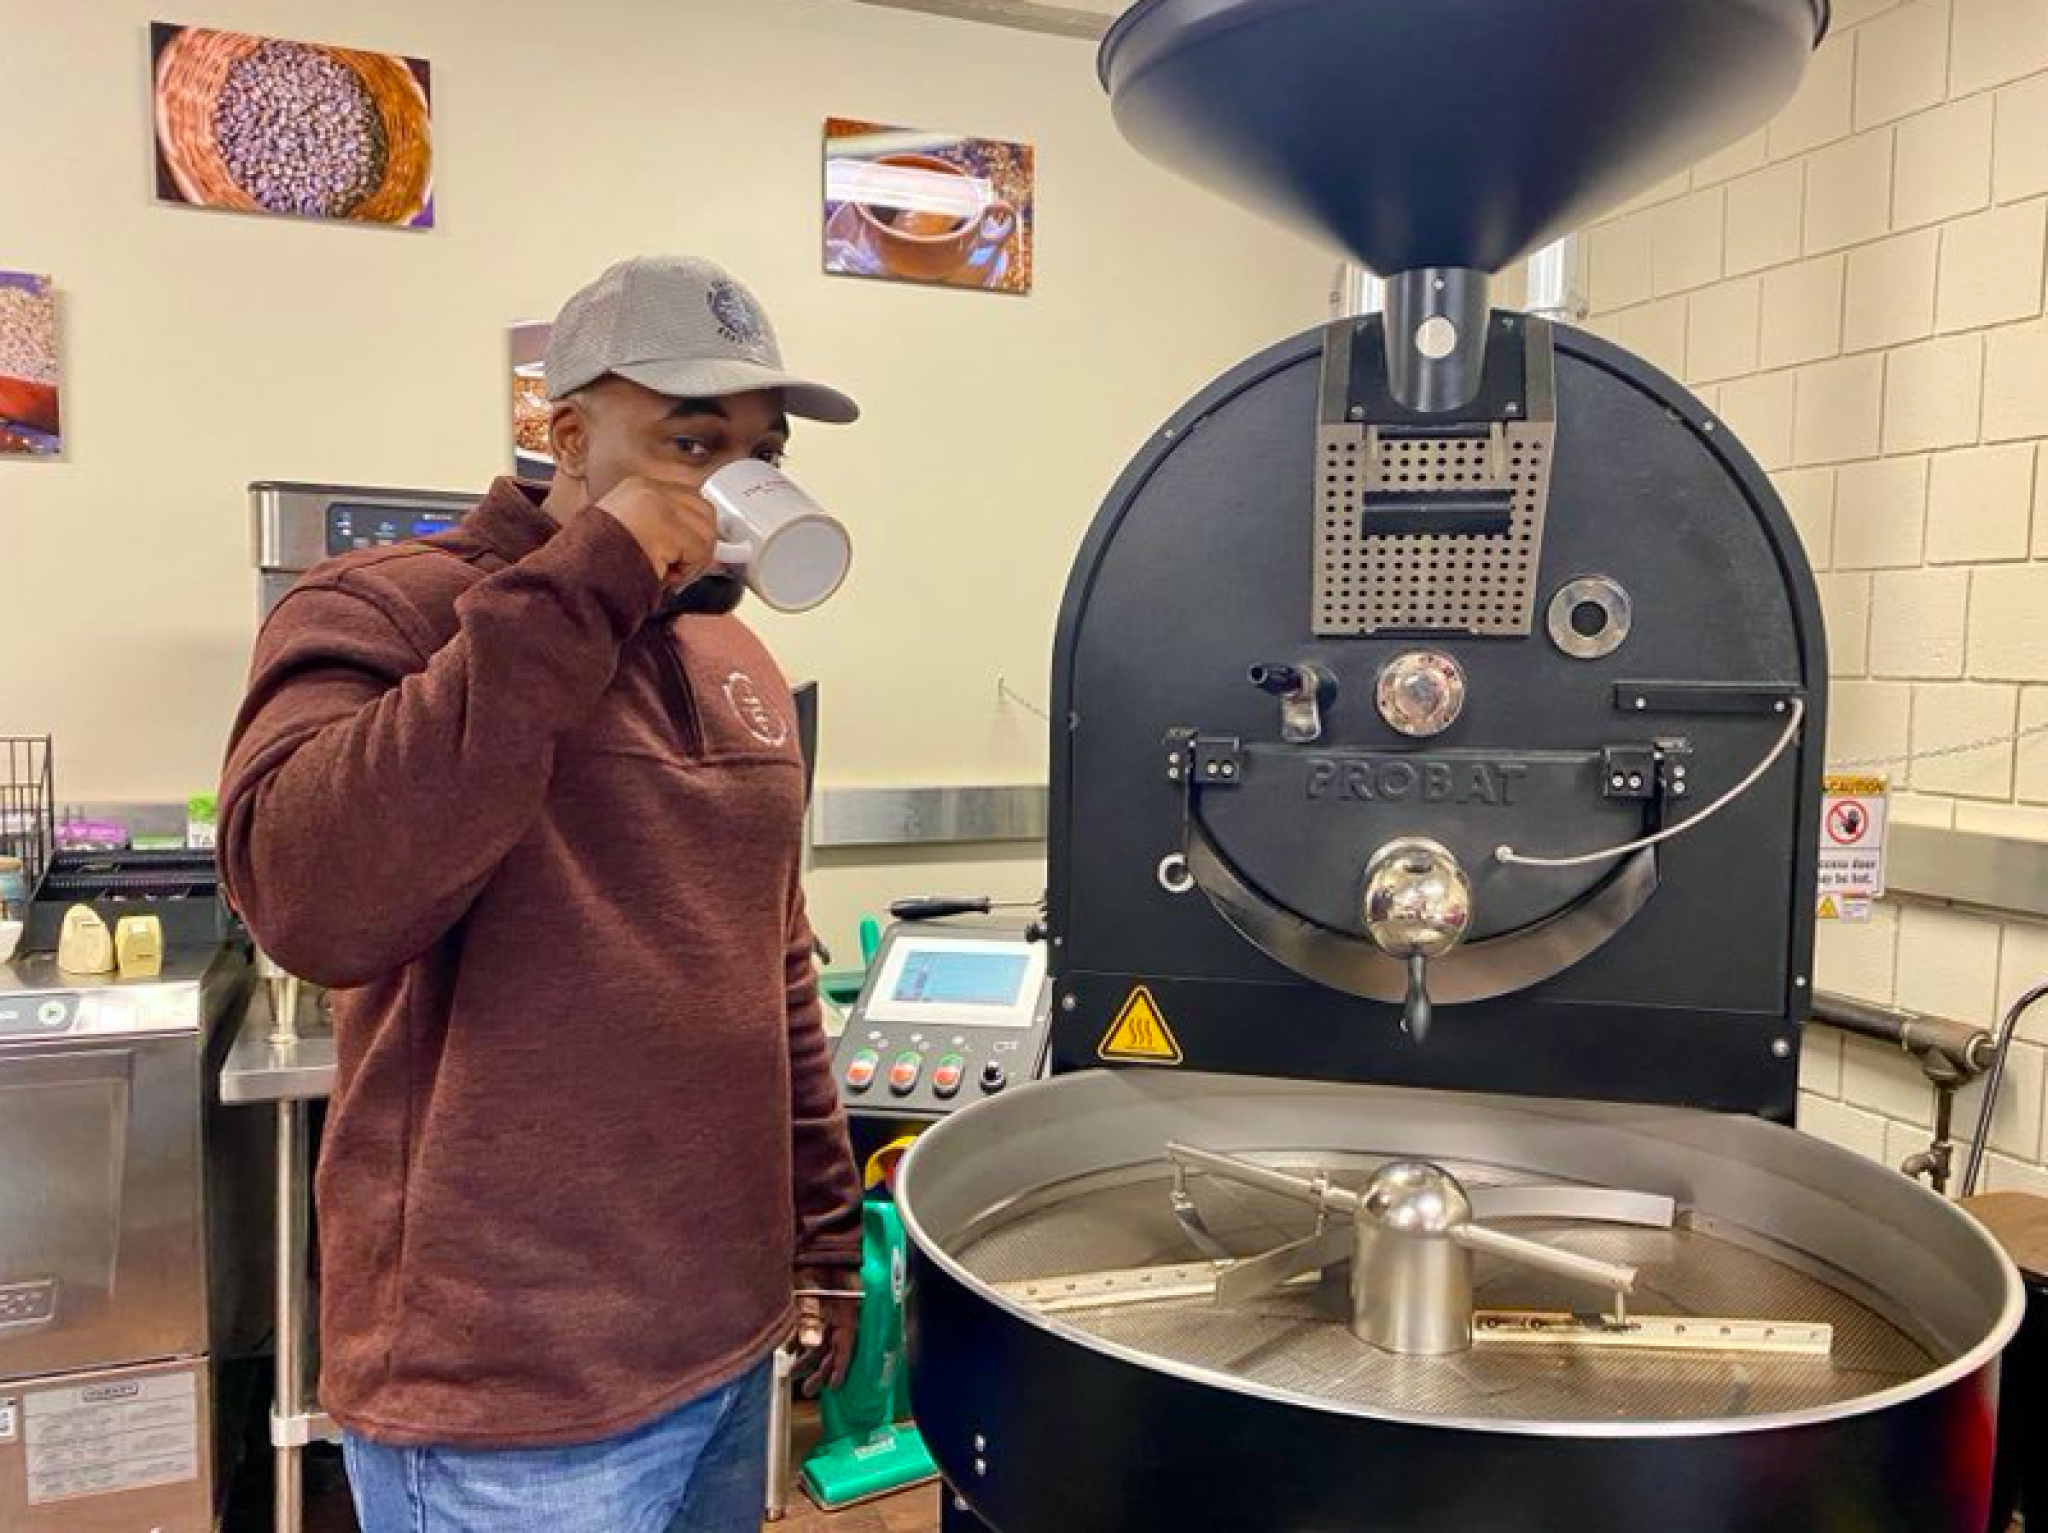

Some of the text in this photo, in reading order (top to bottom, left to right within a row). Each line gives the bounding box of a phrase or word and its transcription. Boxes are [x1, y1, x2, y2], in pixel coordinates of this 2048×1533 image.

[1306, 758, 1528, 806] PROBAT
[1829, 779, 1885, 794] CAUTION
[1818, 859, 1849, 869] ccess
